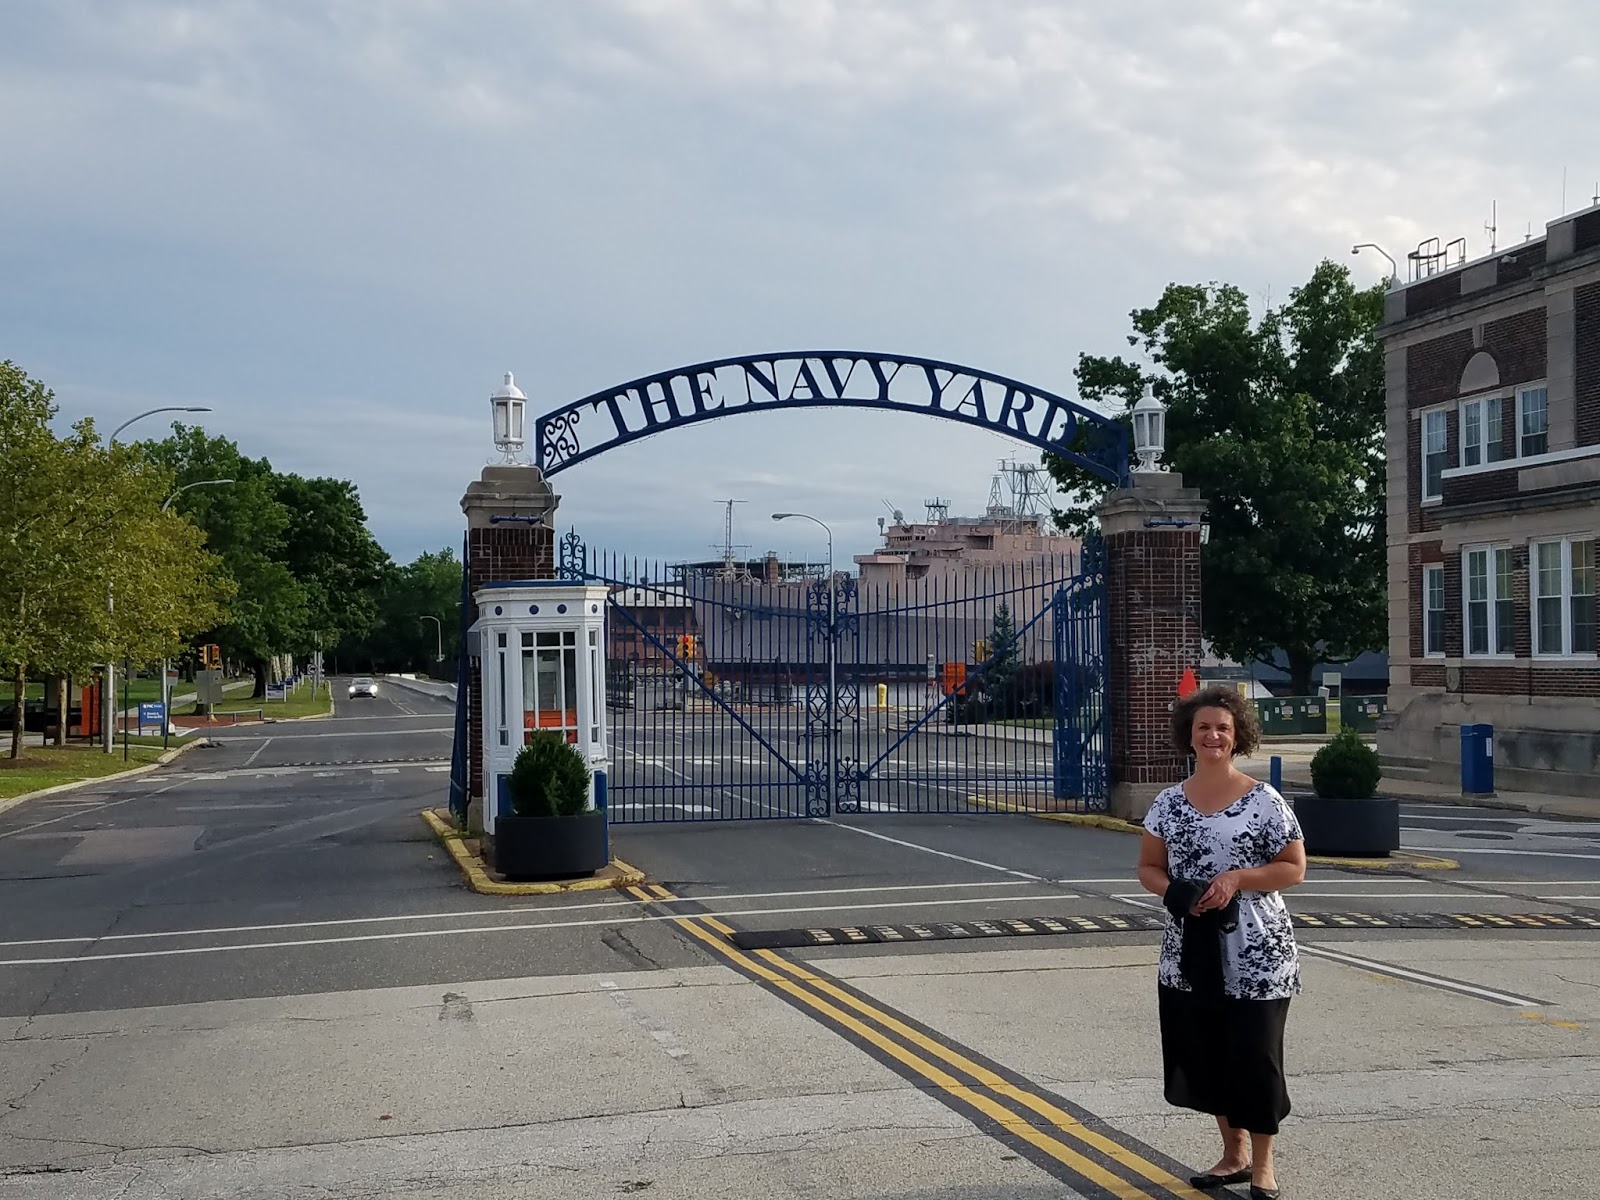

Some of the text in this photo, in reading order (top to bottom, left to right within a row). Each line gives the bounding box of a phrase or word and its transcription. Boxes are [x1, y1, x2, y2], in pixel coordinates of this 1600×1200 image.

[590, 356, 1078, 446] THE NAVY YARD
